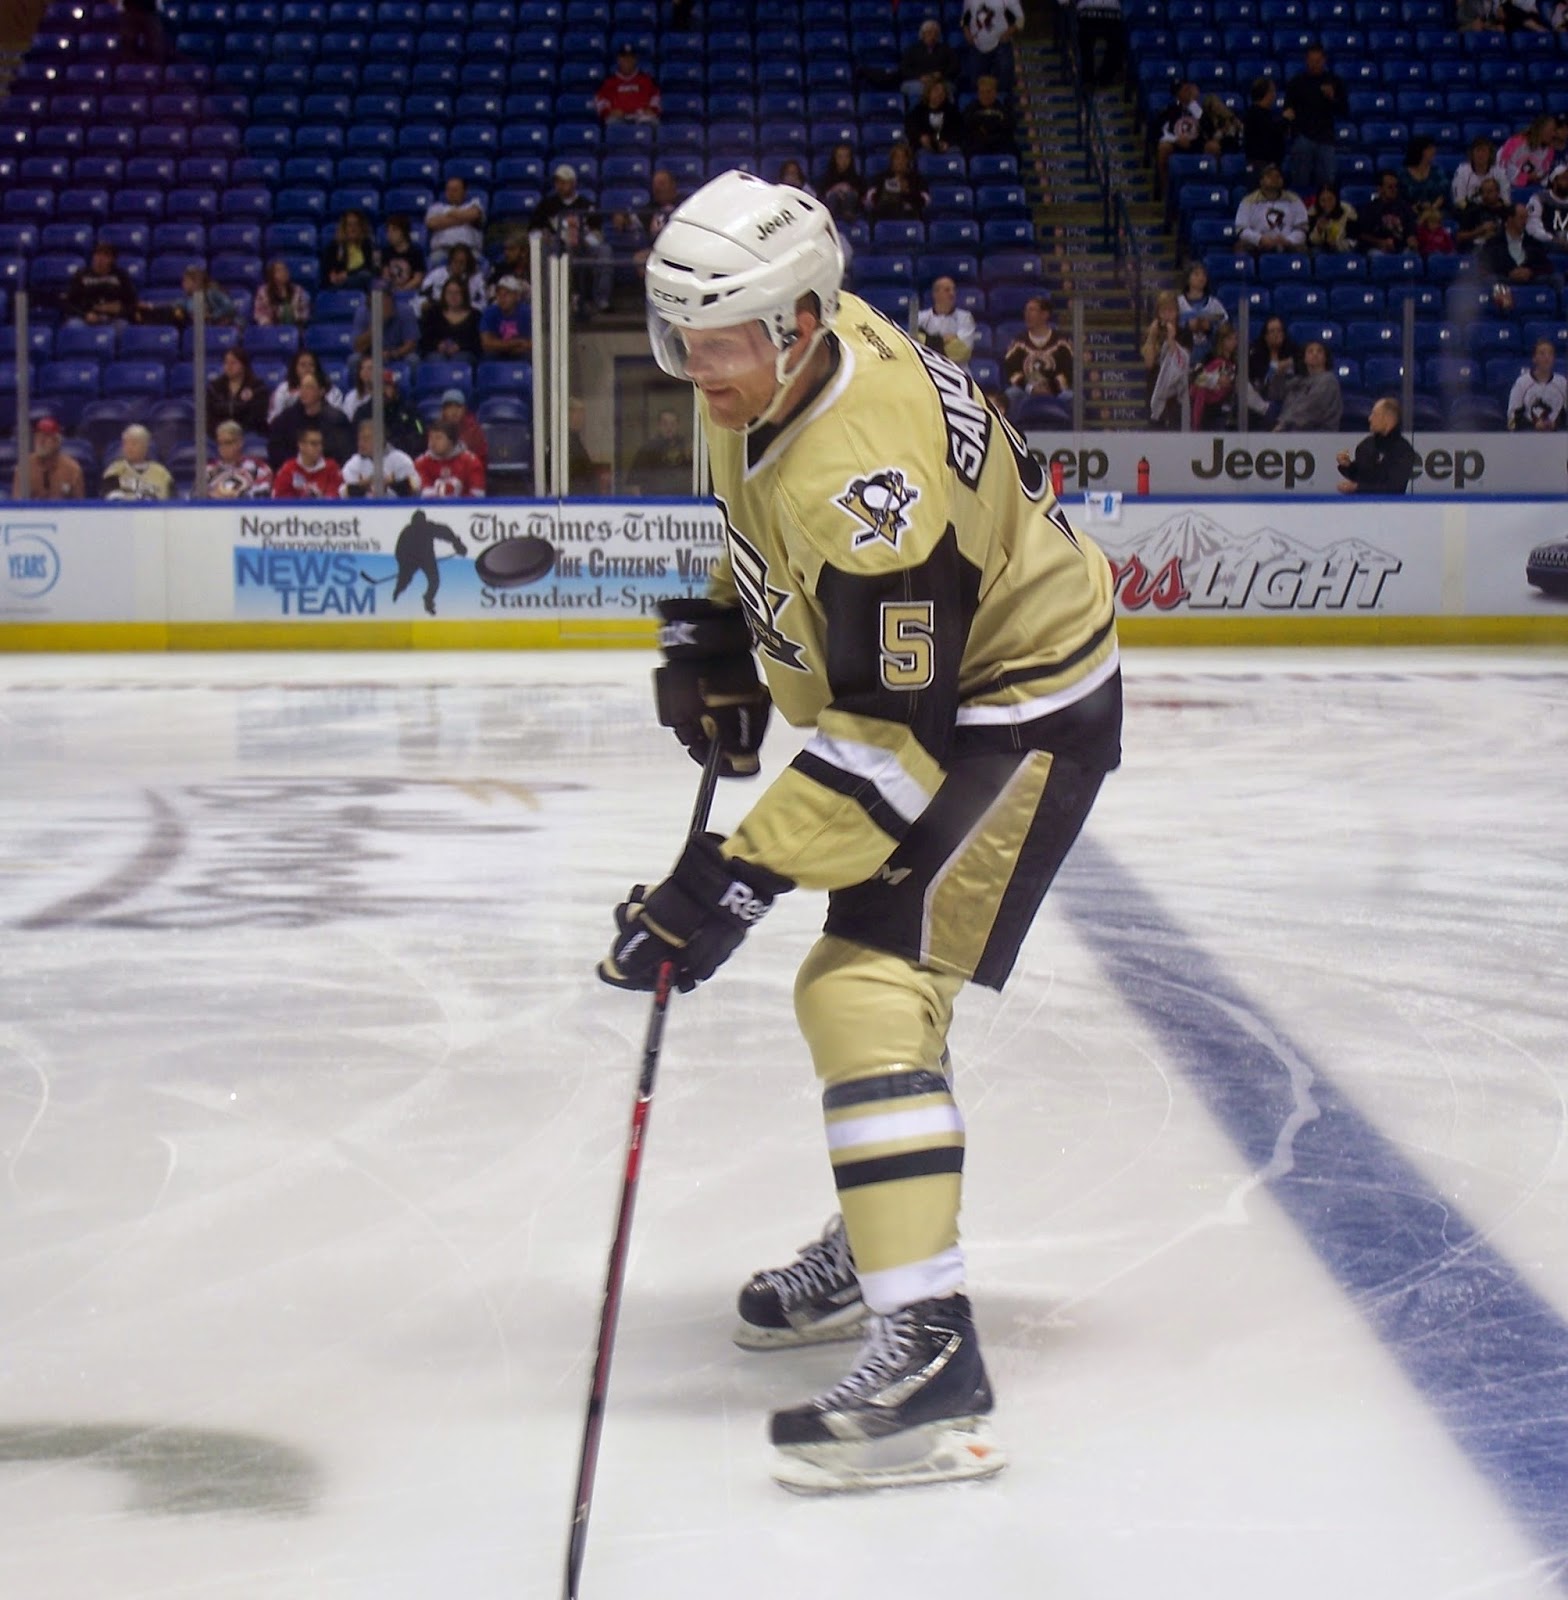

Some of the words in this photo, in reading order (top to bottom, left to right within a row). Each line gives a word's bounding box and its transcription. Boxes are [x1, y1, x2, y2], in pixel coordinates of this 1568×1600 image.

[756, 209, 797, 241] Jeep
[653, 288, 688, 305] CCM
[1191, 437, 1316, 490] Jeep
[241, 514, 361, 538] Northeast
[470, 512, 520, 543] The
[527, 512, 724, 543] Times-Tribun
[7, 553, 47, 579] YEARS
[236, 552, 359, 588] NEWS
[588, 549, 671, 579] CITIZENS'
[1188, 558, 1403, 609] LIGHT
[274, 585, 377, 615] TEAM
[880, 600, 935, 691] 5
